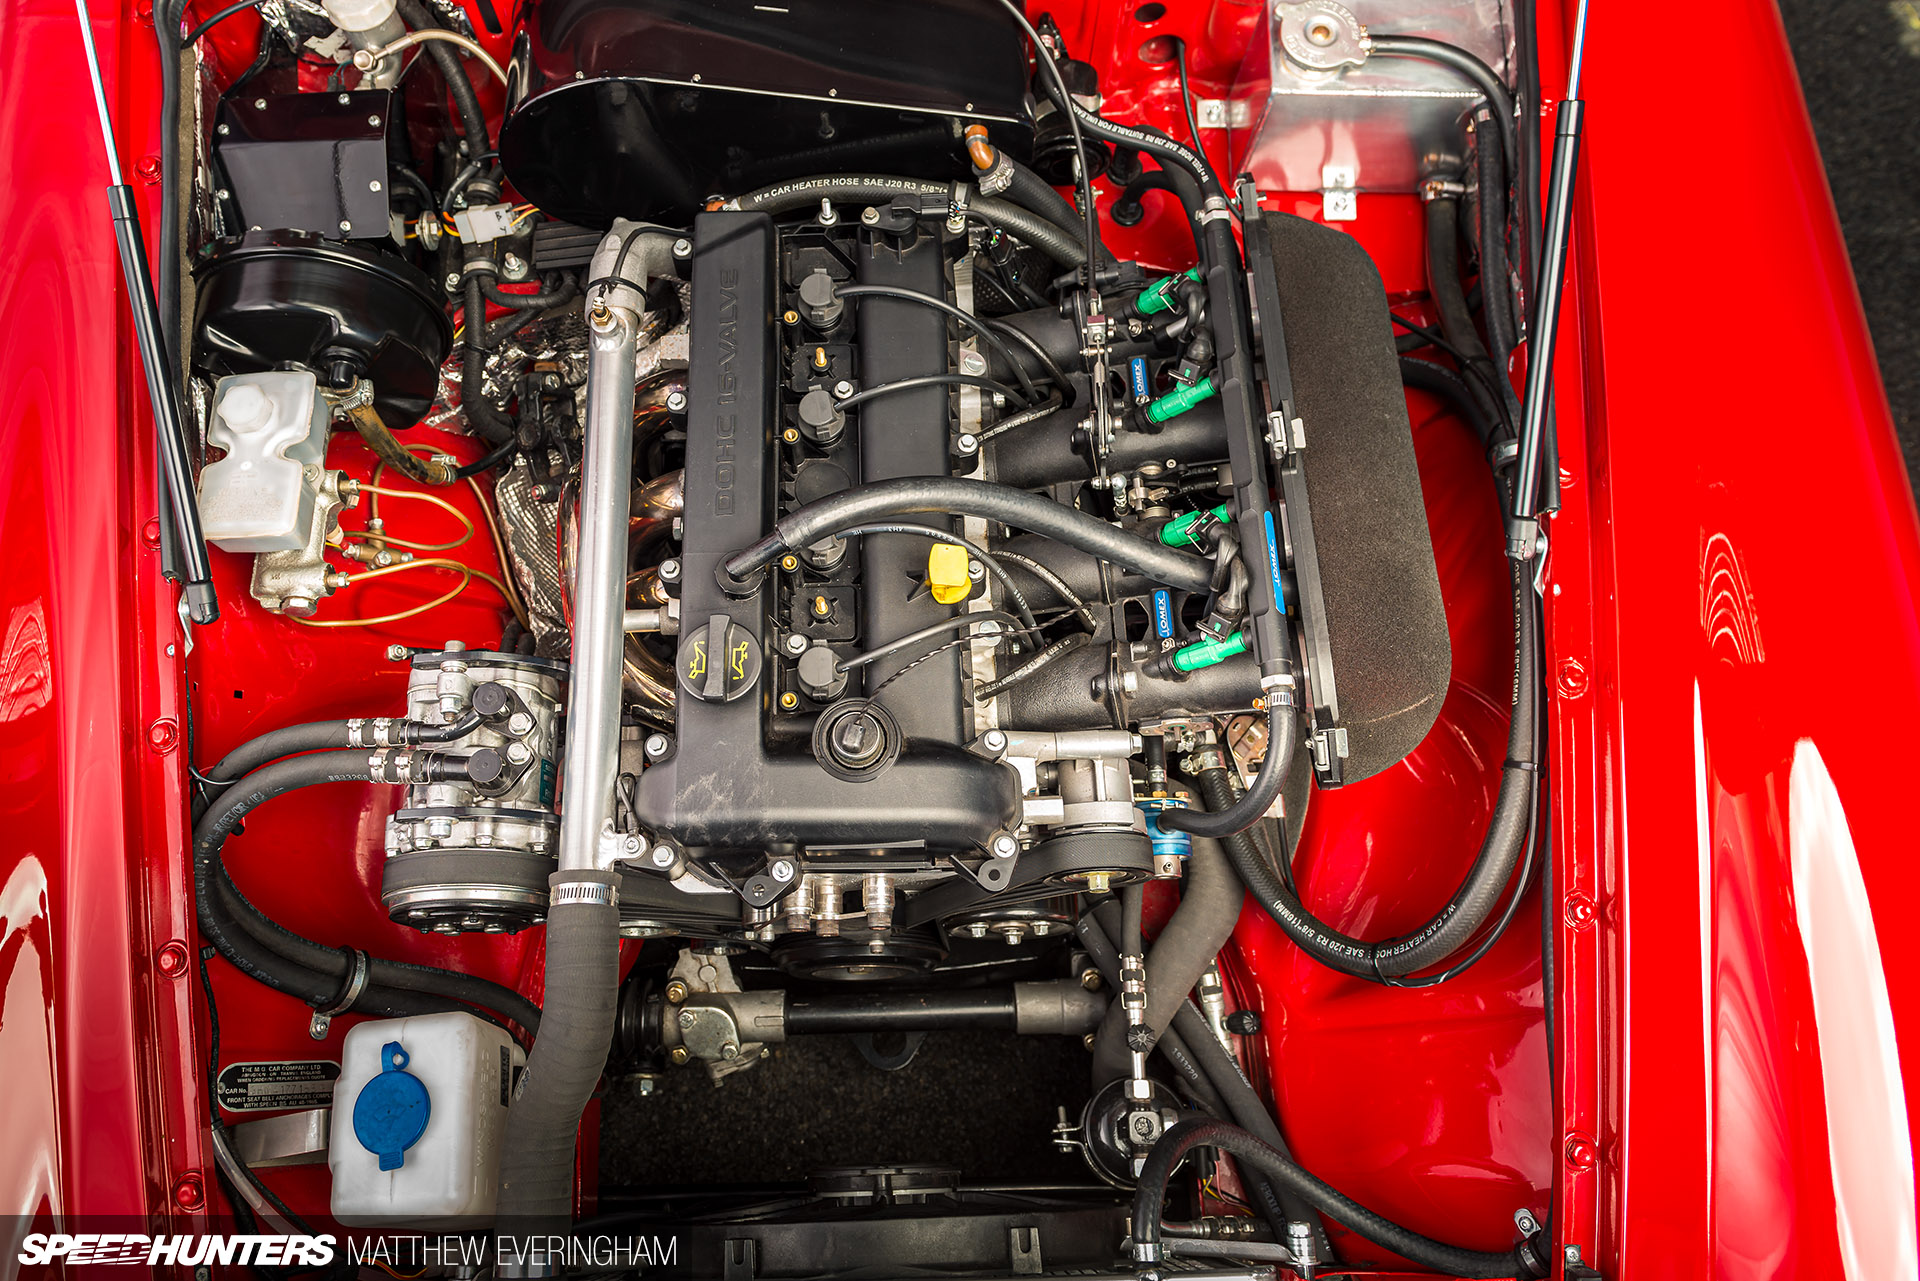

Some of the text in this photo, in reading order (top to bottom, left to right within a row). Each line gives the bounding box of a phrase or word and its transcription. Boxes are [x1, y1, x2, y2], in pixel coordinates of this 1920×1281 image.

[1098, 119, 1112, 132] FOR
[1112, 125, 1144, 140] SUITABLE
[1165, 140, 1179, 151] SAE
[1178, 147, 1194, 160] HOSE
[1192, 158, 1203, 173] FUEL
[753, 194, 763, 203] W
[771, 185, 791, 197] CAR
[792, 178, 830, 191] HEATER
[832, 178, 859, 186] HOSE
[864, 178, 883, 186] SAE
[885, 179, 901, 188] J20
[904, 182, 916, 190] R3
[715, 268, 738, 516] DOHC 16-VALVE
[1447, 904, 1456, 916] W
[1273, 900, 1315, 938] 5/8"(16MM)
[1426, 919, 1443, 937] CAR
[1316, 935, 1329, 946] R3
[1329, 940, 1345, 952] J20
[1393, 933, 1427, 956] HEATER
[1345, 945, 1365, 958] SAE
